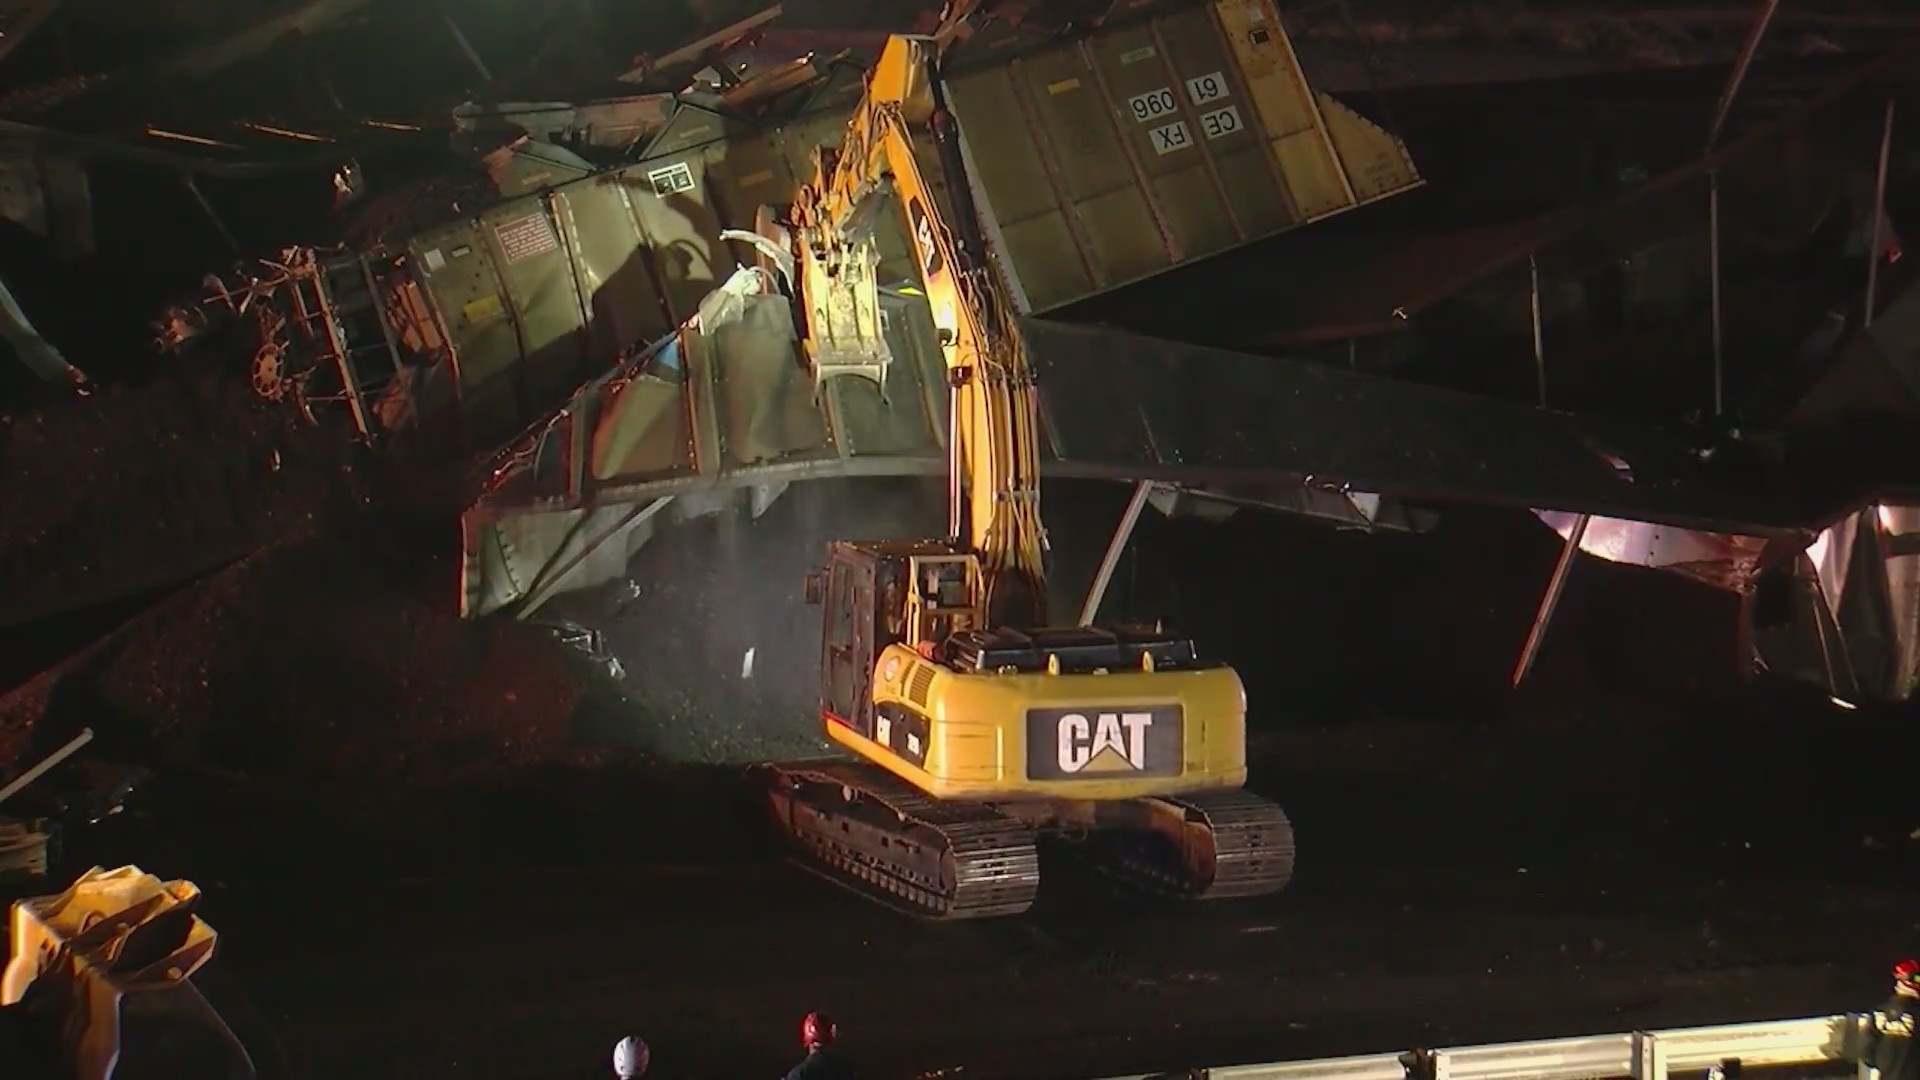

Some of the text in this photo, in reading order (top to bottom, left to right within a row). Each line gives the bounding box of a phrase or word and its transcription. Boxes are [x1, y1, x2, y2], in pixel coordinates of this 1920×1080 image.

[1132, 78, 1218, 118] 61 096
[1157, 111, 1235, 149] CE FX
[1058, 712, 1152, 773] CAT
